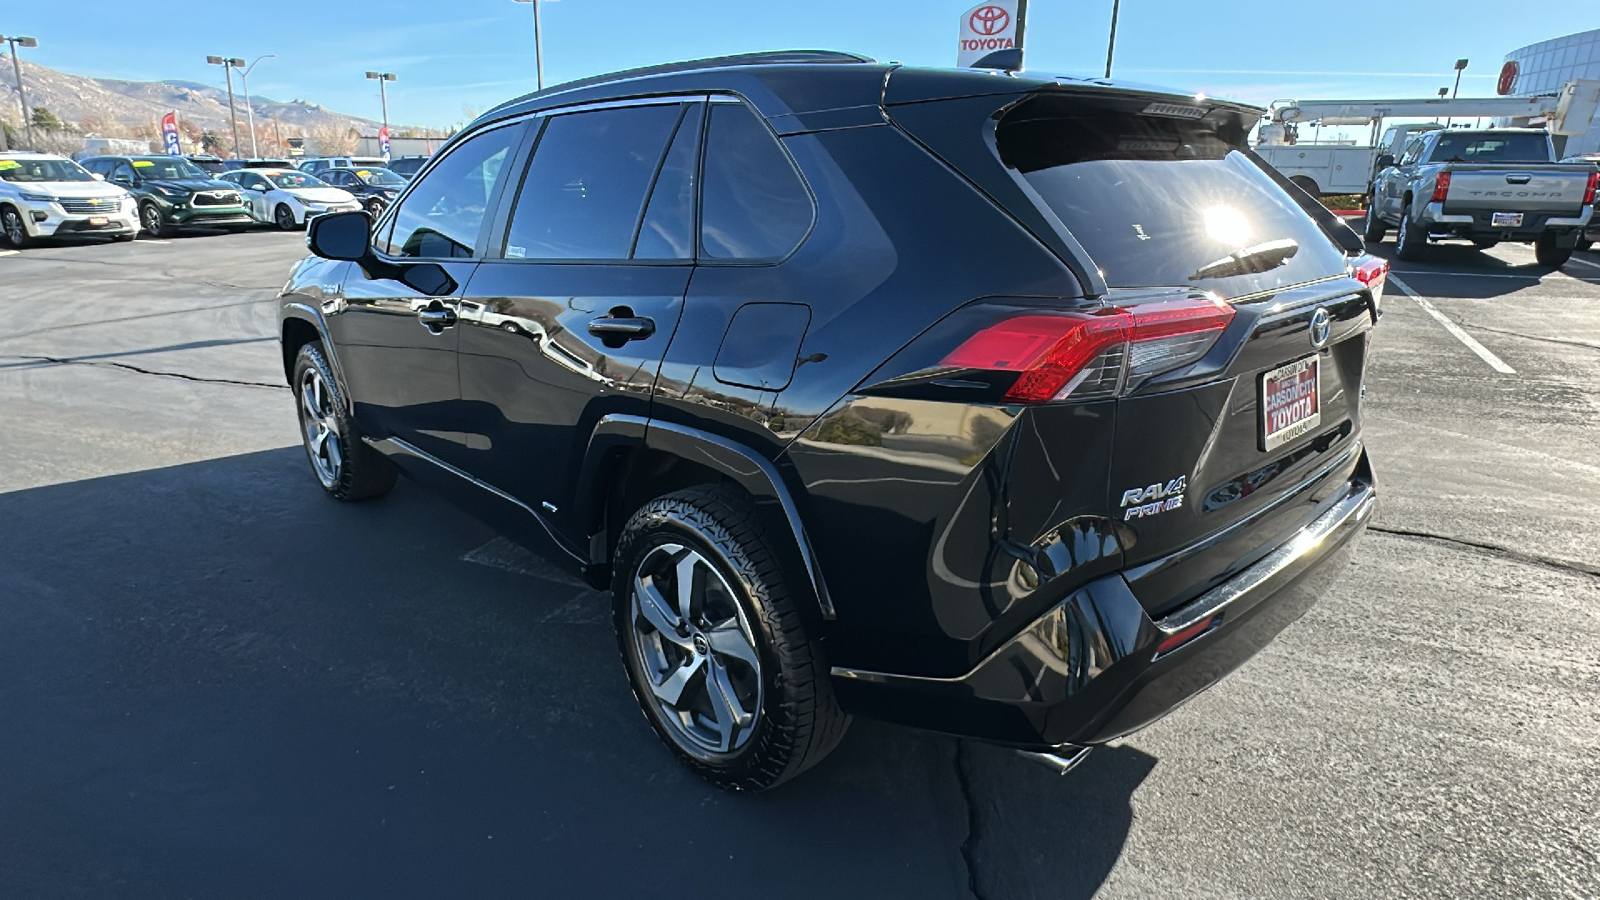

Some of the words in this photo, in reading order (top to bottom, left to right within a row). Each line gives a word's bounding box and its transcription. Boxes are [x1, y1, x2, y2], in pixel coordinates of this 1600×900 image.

[961, 38, 1014, 51] TOYOTA
[1266, 386, 1298, 411] CARSON
[1300, 378, 1316, 395] CITY
[1271, 396, 1312, 432] TOYOTA
[1120, 475, 1186, 507] RAV4
[1124, 495, 1184, 521] PRIME
